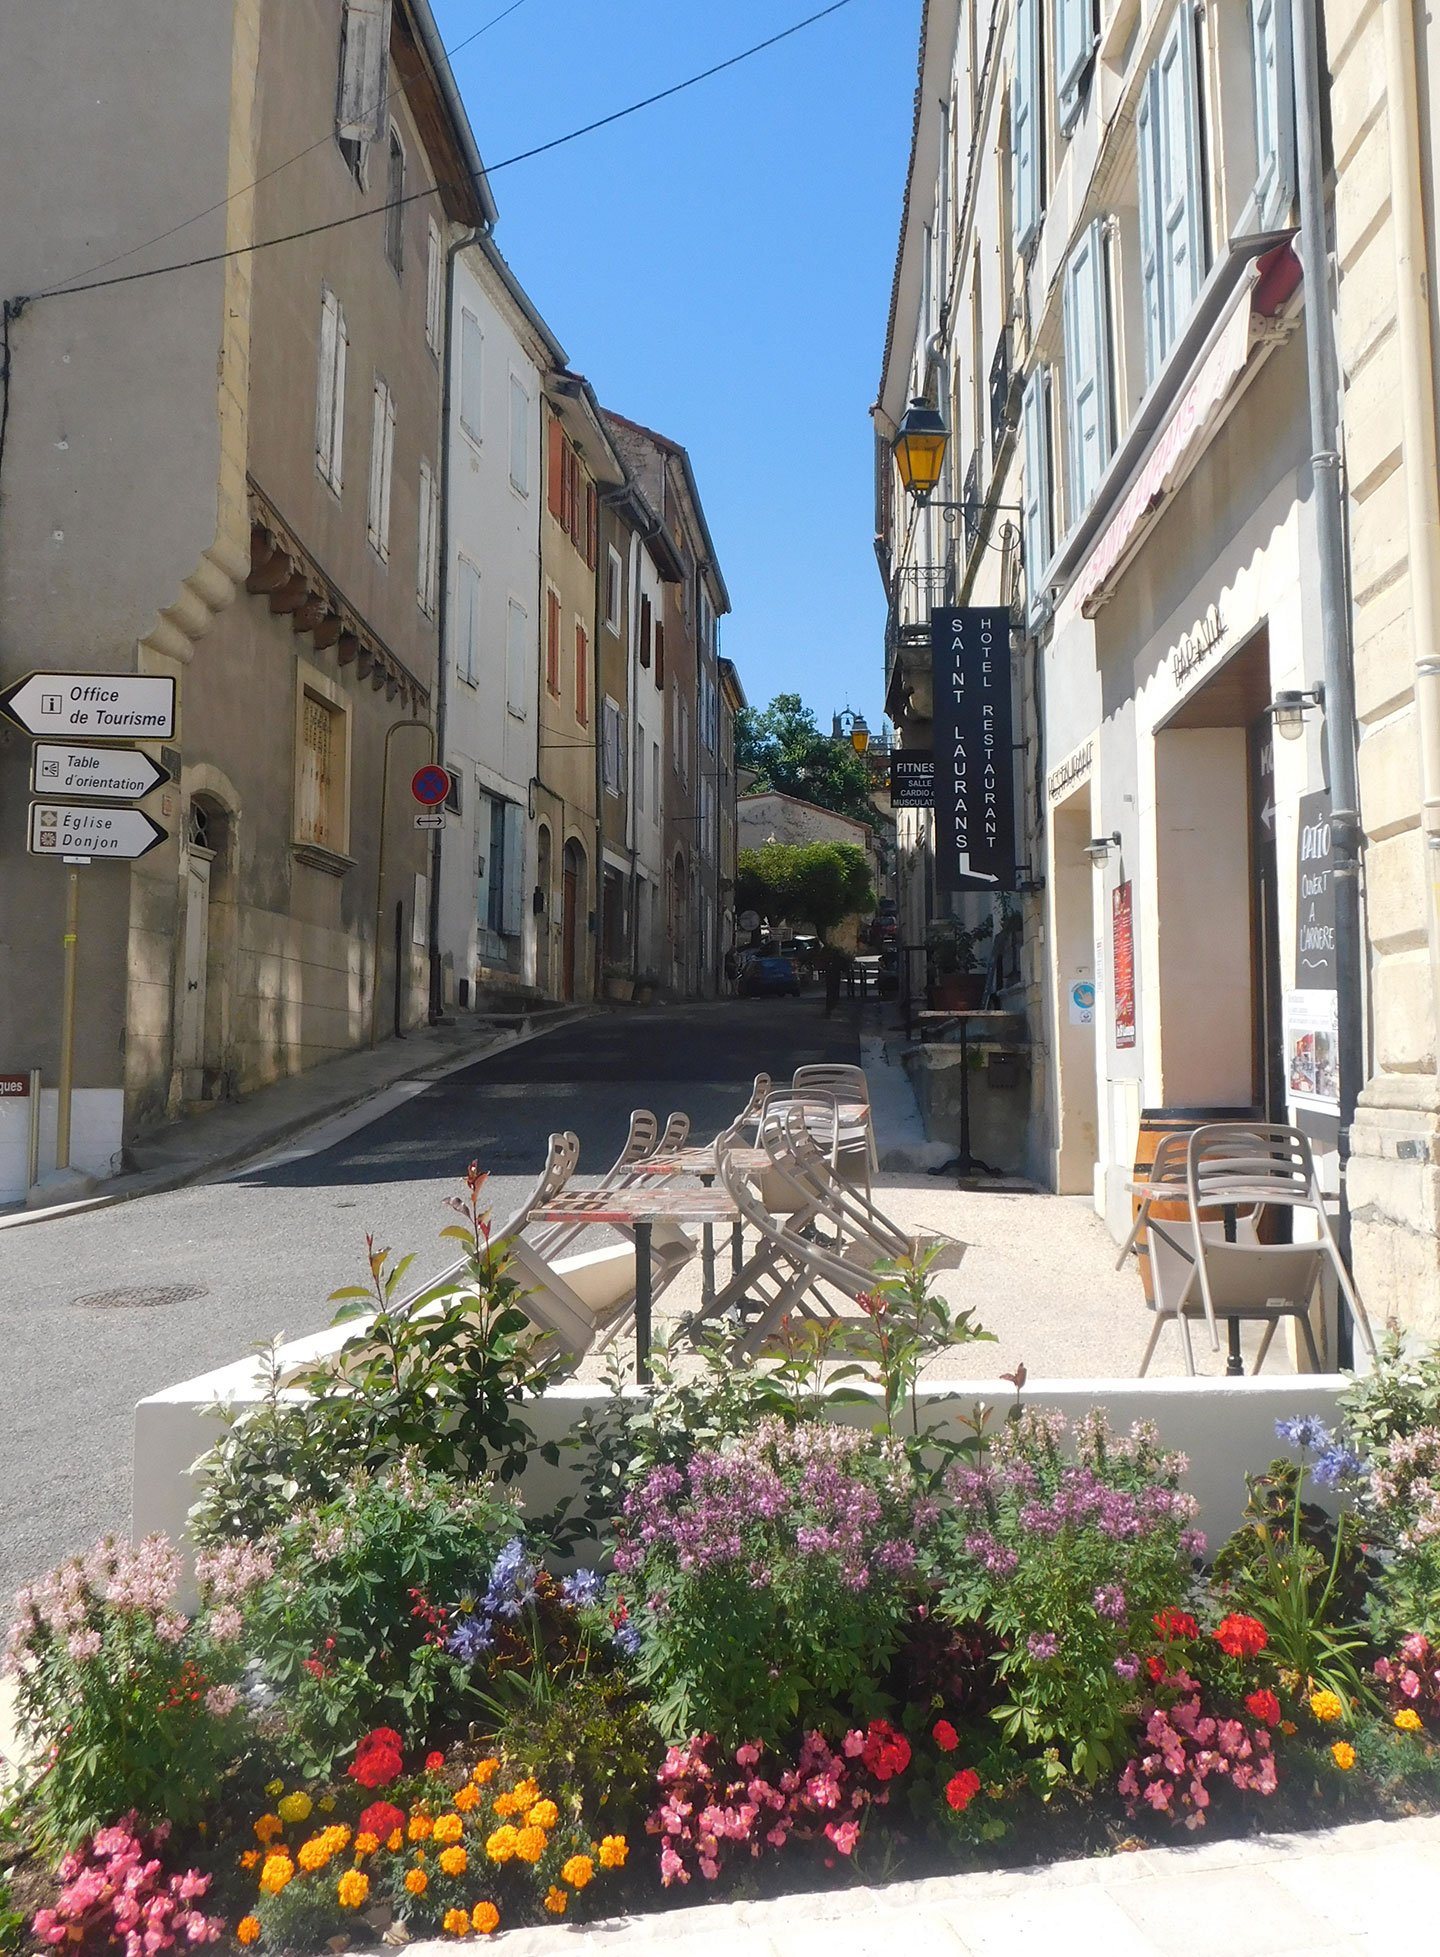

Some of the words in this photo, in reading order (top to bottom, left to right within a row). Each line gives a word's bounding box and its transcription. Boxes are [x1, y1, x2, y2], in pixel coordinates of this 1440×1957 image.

[981, 618, 993, 687] HOTEL
[951, 619, 965, 704] SAINT
[70, 686, 119, 702] Office
[69, 709, 89, 724] de
[96, 710, 166, 726] Tourisme
[67, 755, 100, 769] Table
[65, 774, 144, 791] d'orientation
[908, 779, 932, 787] SALLE
[983, 705, 997, 848] RESTAURANT
[900, 789, 930, 797] CARDIO
[953, 726, 968, 848] LAURANS
[63, 812, 112, 830] Église
[62, 833, 118, 850] Donjon
[1301, 813, 1332, 861] PATIO
[1302, 870, 1331, 899] OUVERT
